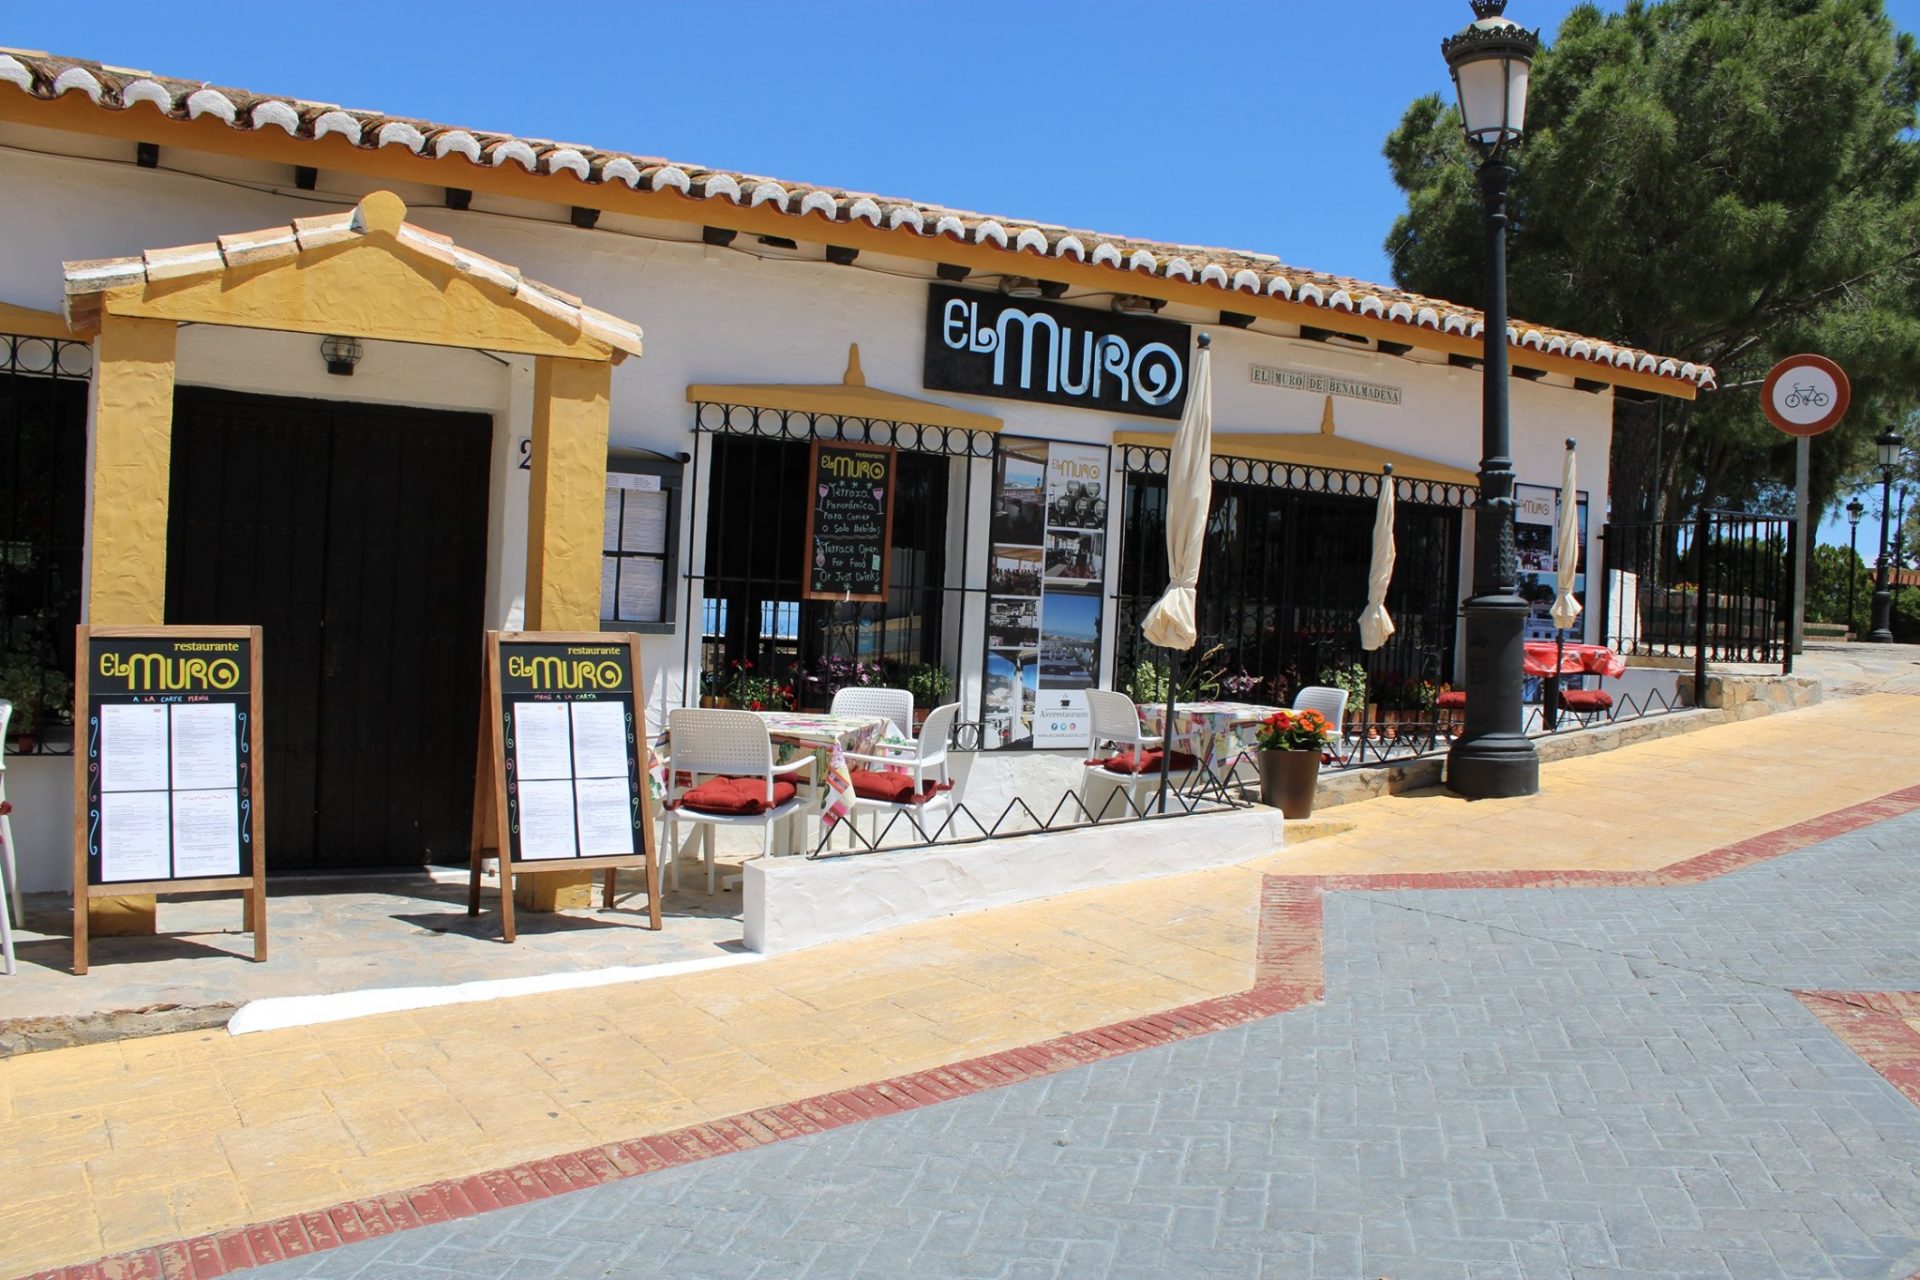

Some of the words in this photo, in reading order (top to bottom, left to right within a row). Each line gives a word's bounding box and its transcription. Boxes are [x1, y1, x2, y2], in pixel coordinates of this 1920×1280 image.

[993, 308, 1183, 406] MURO
[1254, 369, 1268, 382] EL
[1275, 372, 1303, 387] MURO
[1309, 378, 1322, 390] DE
[1329, 381, 1399, 403] BENALMADENA
[519, 439, 531, 470] 2
[833, 456, 885, 480] MURO
[828, 482, 870, 498] Terraza
[822, 541, 855, 554] Terrace
[858, 543, 879, 559] Open
[832, 557, 844, 567] For
[849, 557, 866, 568] Food
[819, 570, 831, 582] Or
[855, 570, 881, 583] Drinks
[174, 642, 240, 652] restaurante
[567, 647, 621, 656] restaurante
[128, 653, 240, 690] MURO
[531, 656, 623, 689] MURO
[160, 695, 183, 703] CARTE
